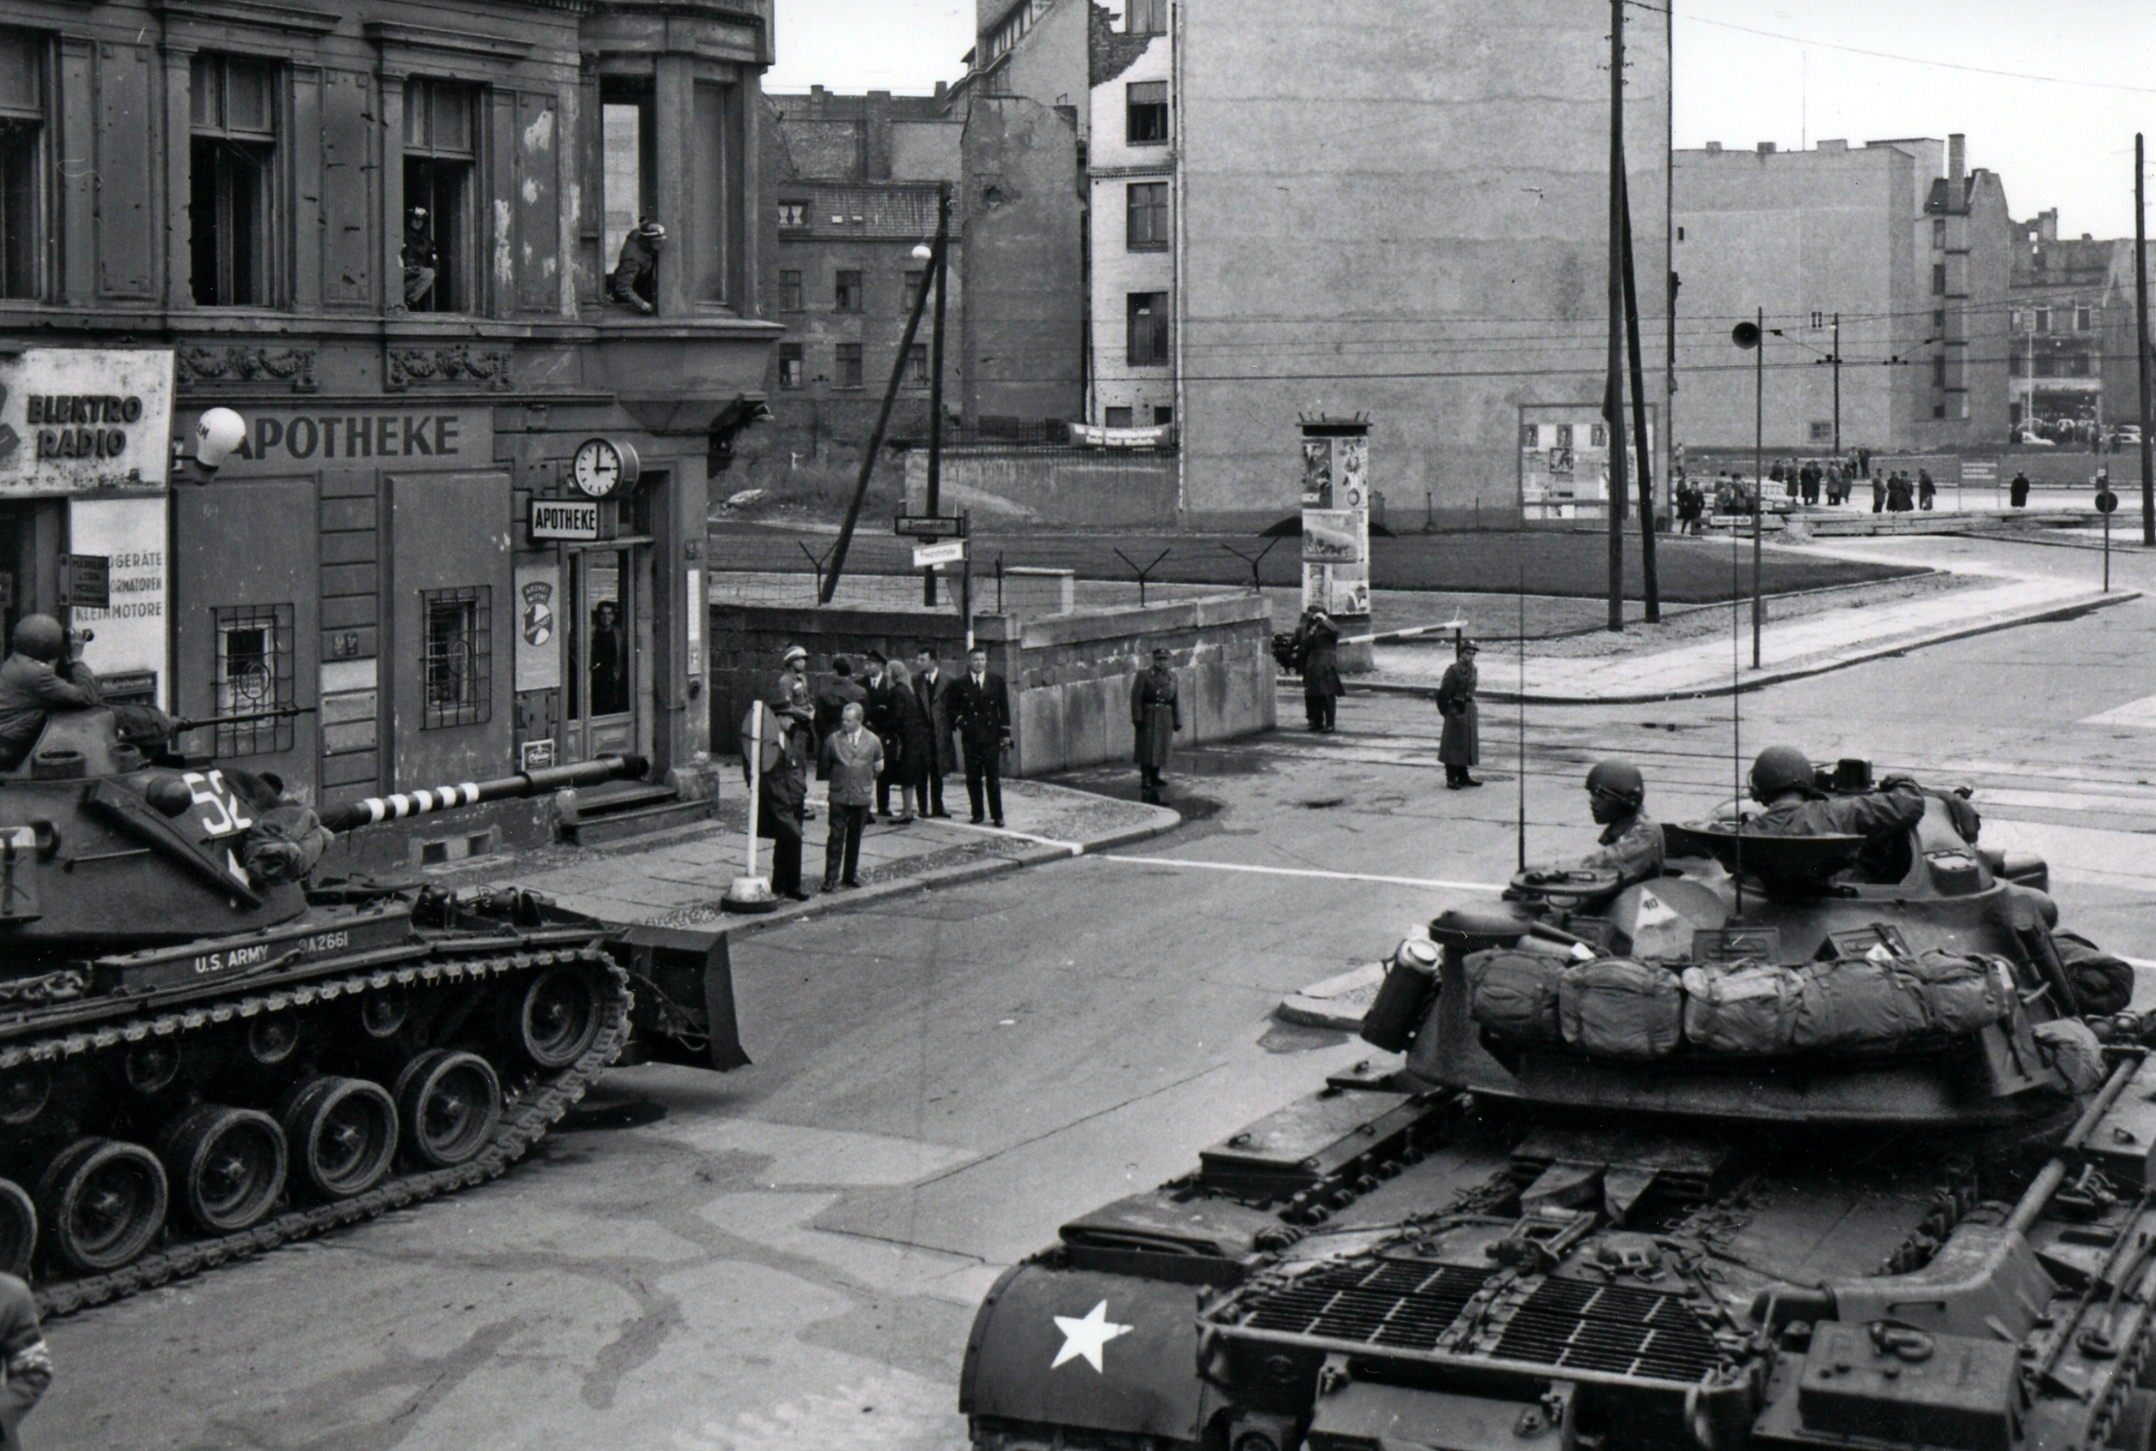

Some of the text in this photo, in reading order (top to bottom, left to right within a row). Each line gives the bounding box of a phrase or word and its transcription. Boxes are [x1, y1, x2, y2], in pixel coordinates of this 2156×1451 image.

[27, 395, 144, 424] ELEKTRO
[37, 429, 127, 459] RADIO
[535, 507, 596, 531] APOTHEKE
[110, 577, 162, 594] ORMATOREN
[182, 770, 252, 835] 52
[195, 953, 224, 974] U.S.
[228, 944, 269, 968] ARMY
